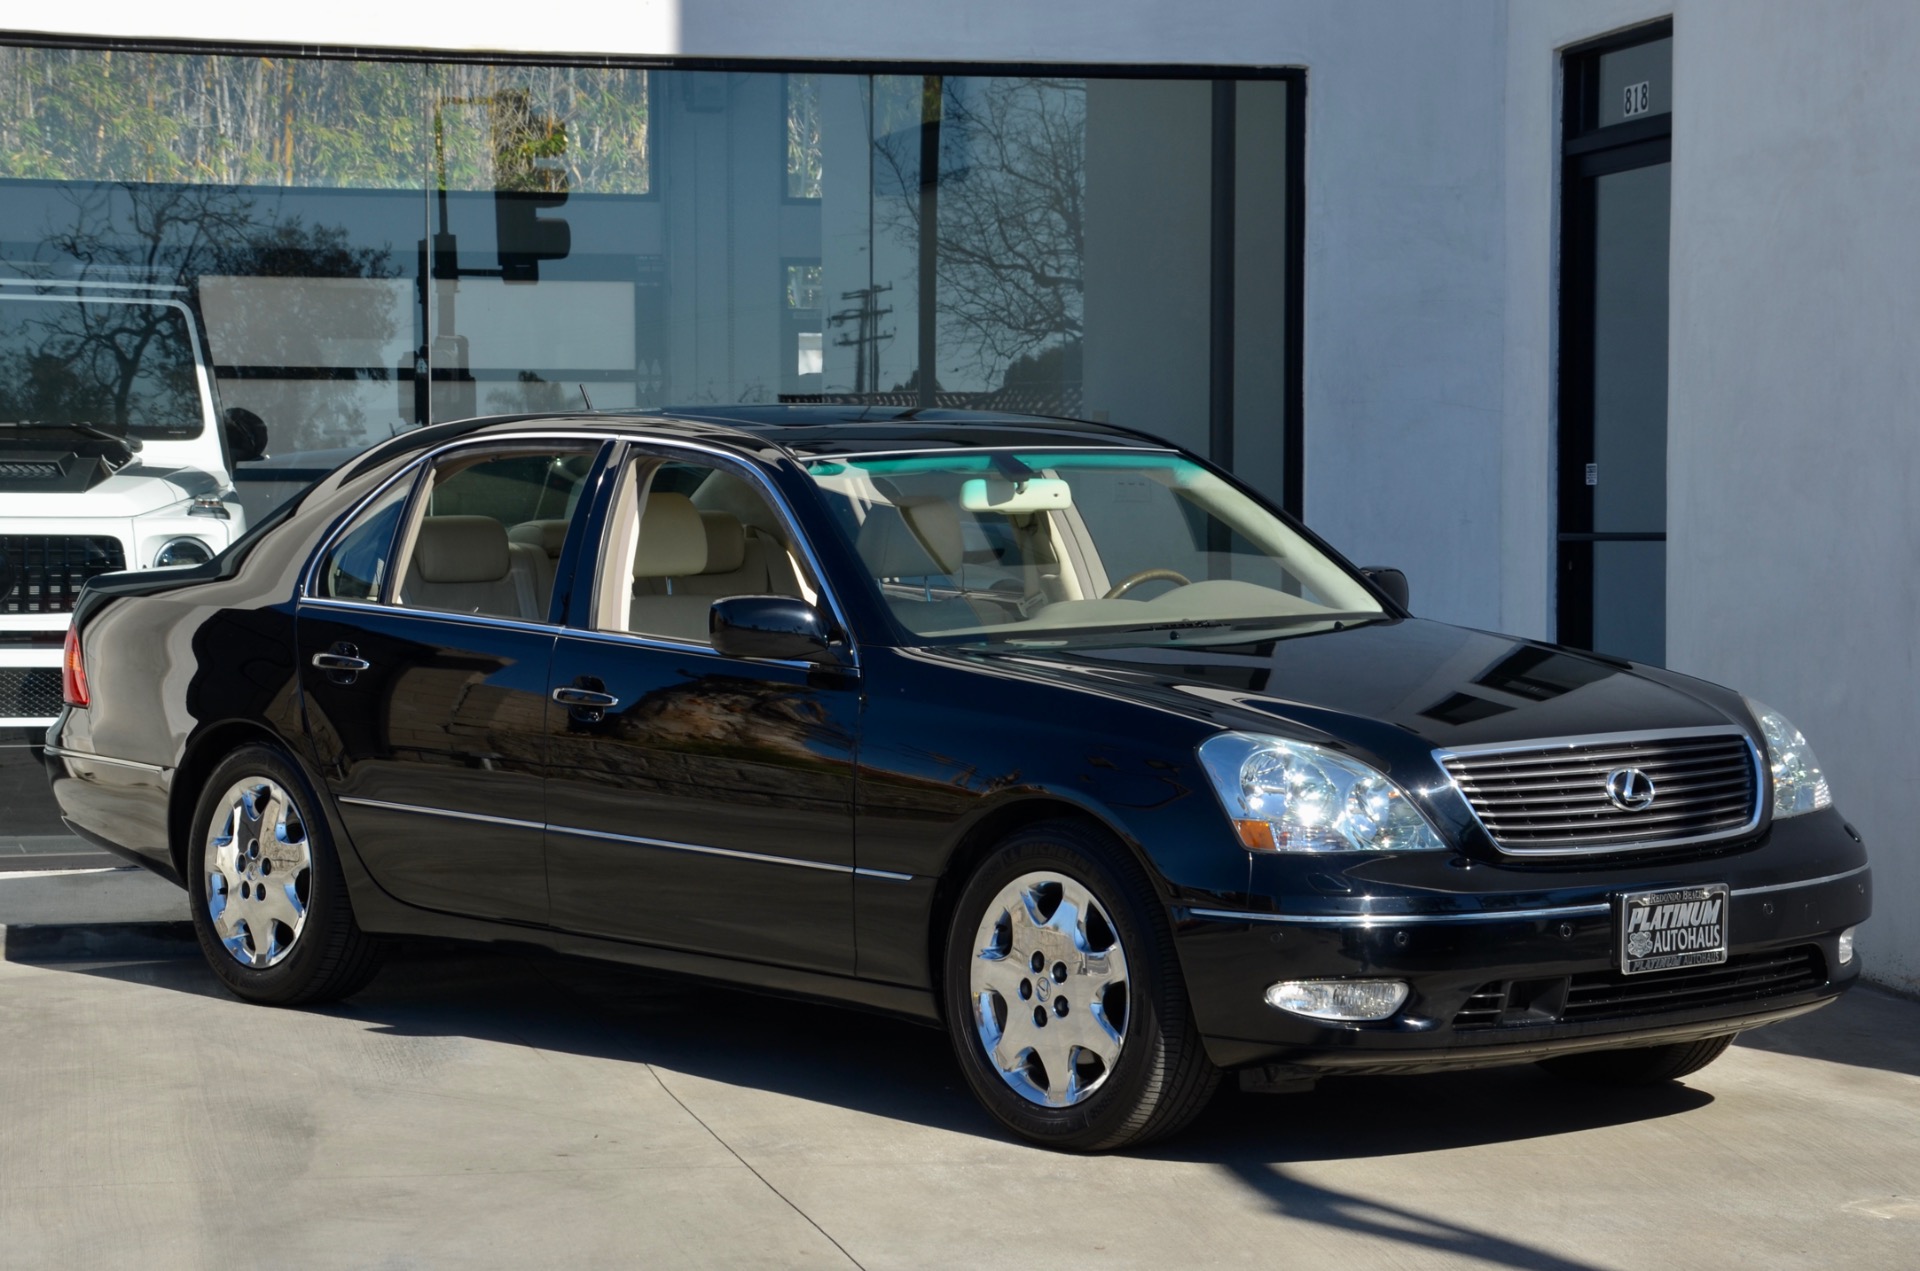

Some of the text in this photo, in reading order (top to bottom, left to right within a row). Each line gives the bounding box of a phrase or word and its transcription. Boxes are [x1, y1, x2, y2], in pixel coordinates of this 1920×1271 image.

[1625, 83, 1648, 115] 818
[1650, 888, 1705, 904] REDONDO BEACH
[1628, 899, 1721, 933] PLATINUM
[1653, 925, 1720, 953] AUTOHAUS
[1633, 952, 1720, 971] PLATINUM AUTOHAUS
